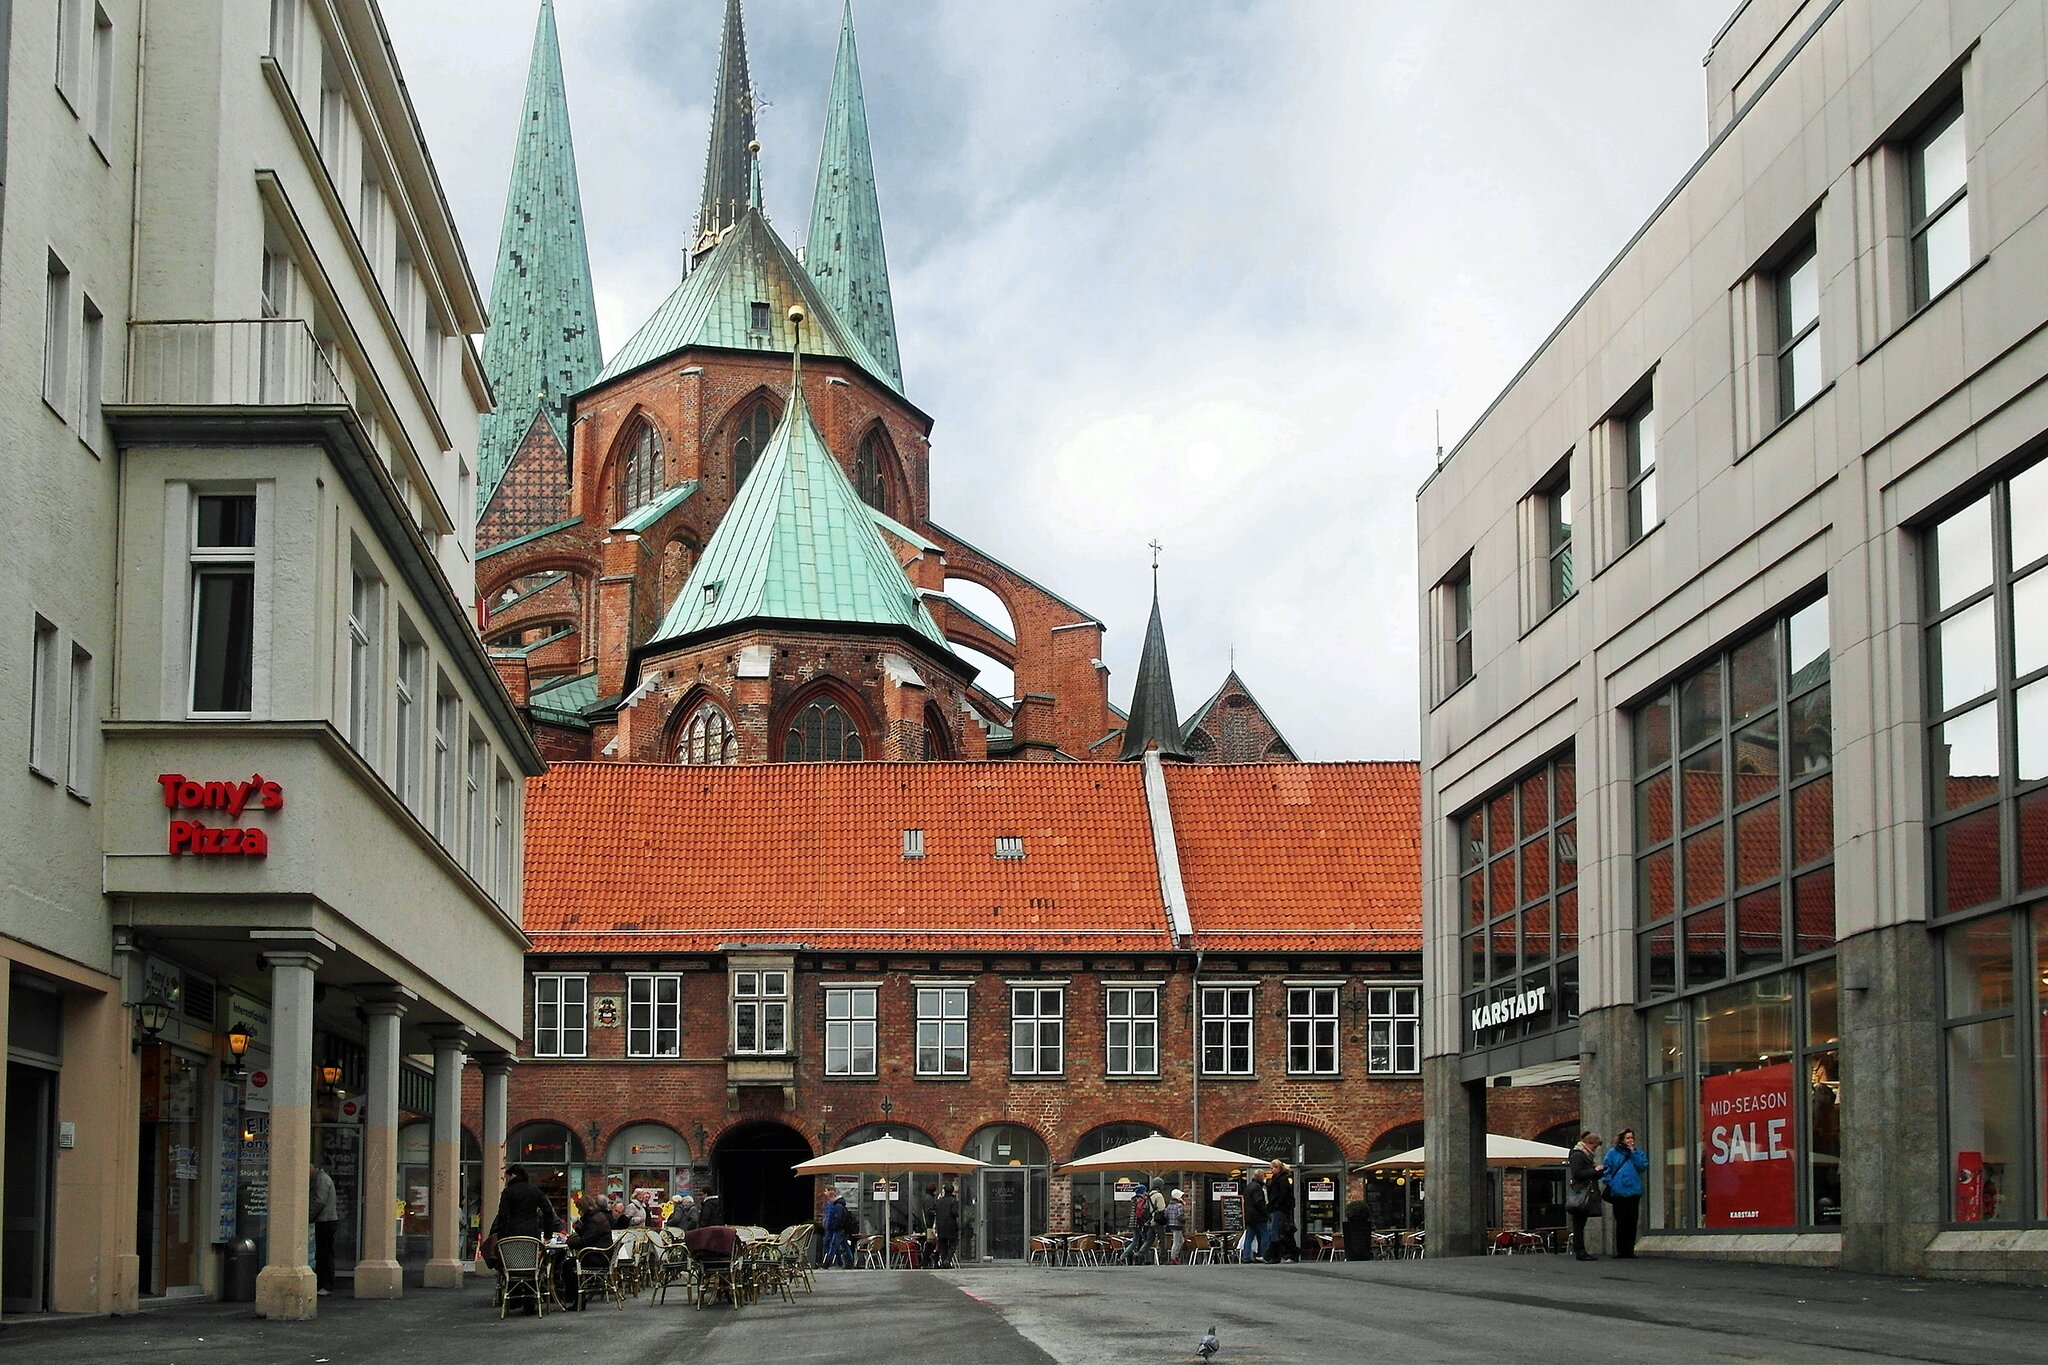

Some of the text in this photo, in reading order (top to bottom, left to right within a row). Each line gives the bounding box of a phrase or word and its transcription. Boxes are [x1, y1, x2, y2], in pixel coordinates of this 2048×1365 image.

[158, 773, 284, 817] Tony's
[169, 820, 268, 857] Pizza
[1472, 987, 1546, 1031] KARSTADT
[1711, 1092, 1787, 1116] MID-SEASON
[1253, 1135, 1293, 1145] WIENER
[1711, 1118, 1787, 1165] SALE
[1730, 1210, 1760, 1219] KARSTADT
